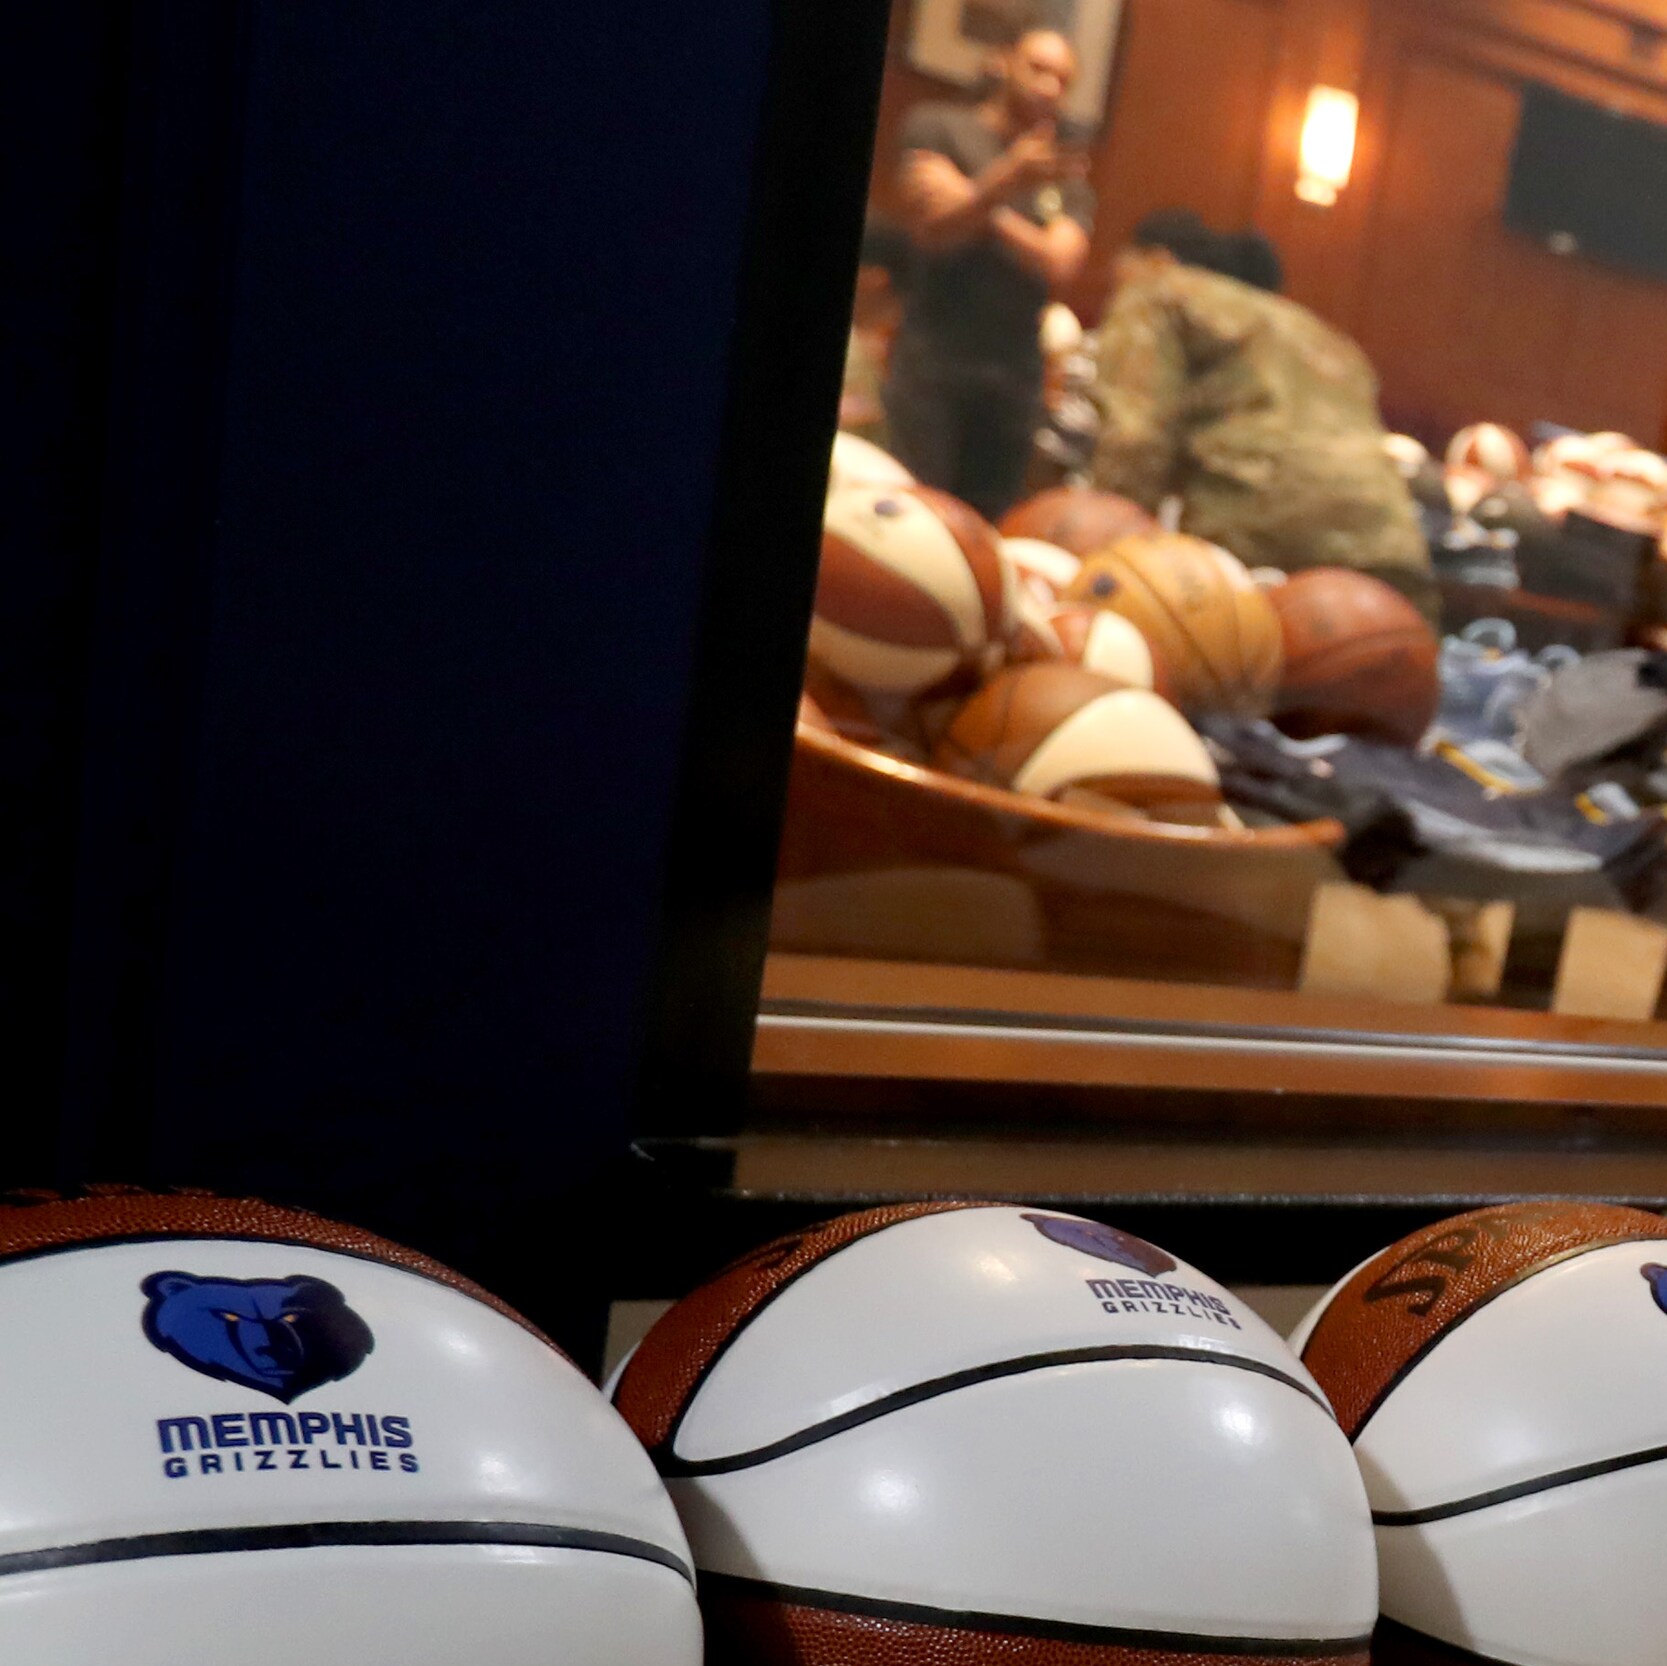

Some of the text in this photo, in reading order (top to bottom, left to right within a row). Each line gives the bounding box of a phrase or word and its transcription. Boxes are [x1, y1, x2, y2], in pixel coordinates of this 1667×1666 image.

[1086, 1279, 1231, 1315] MEMPHIS
[1102, 1301, 1242, 1330] GRIZZLIES
[156, 1411, 413, 1453] MEMPHIS
[163, 1450, 419, 1478] GRIZZLIES
